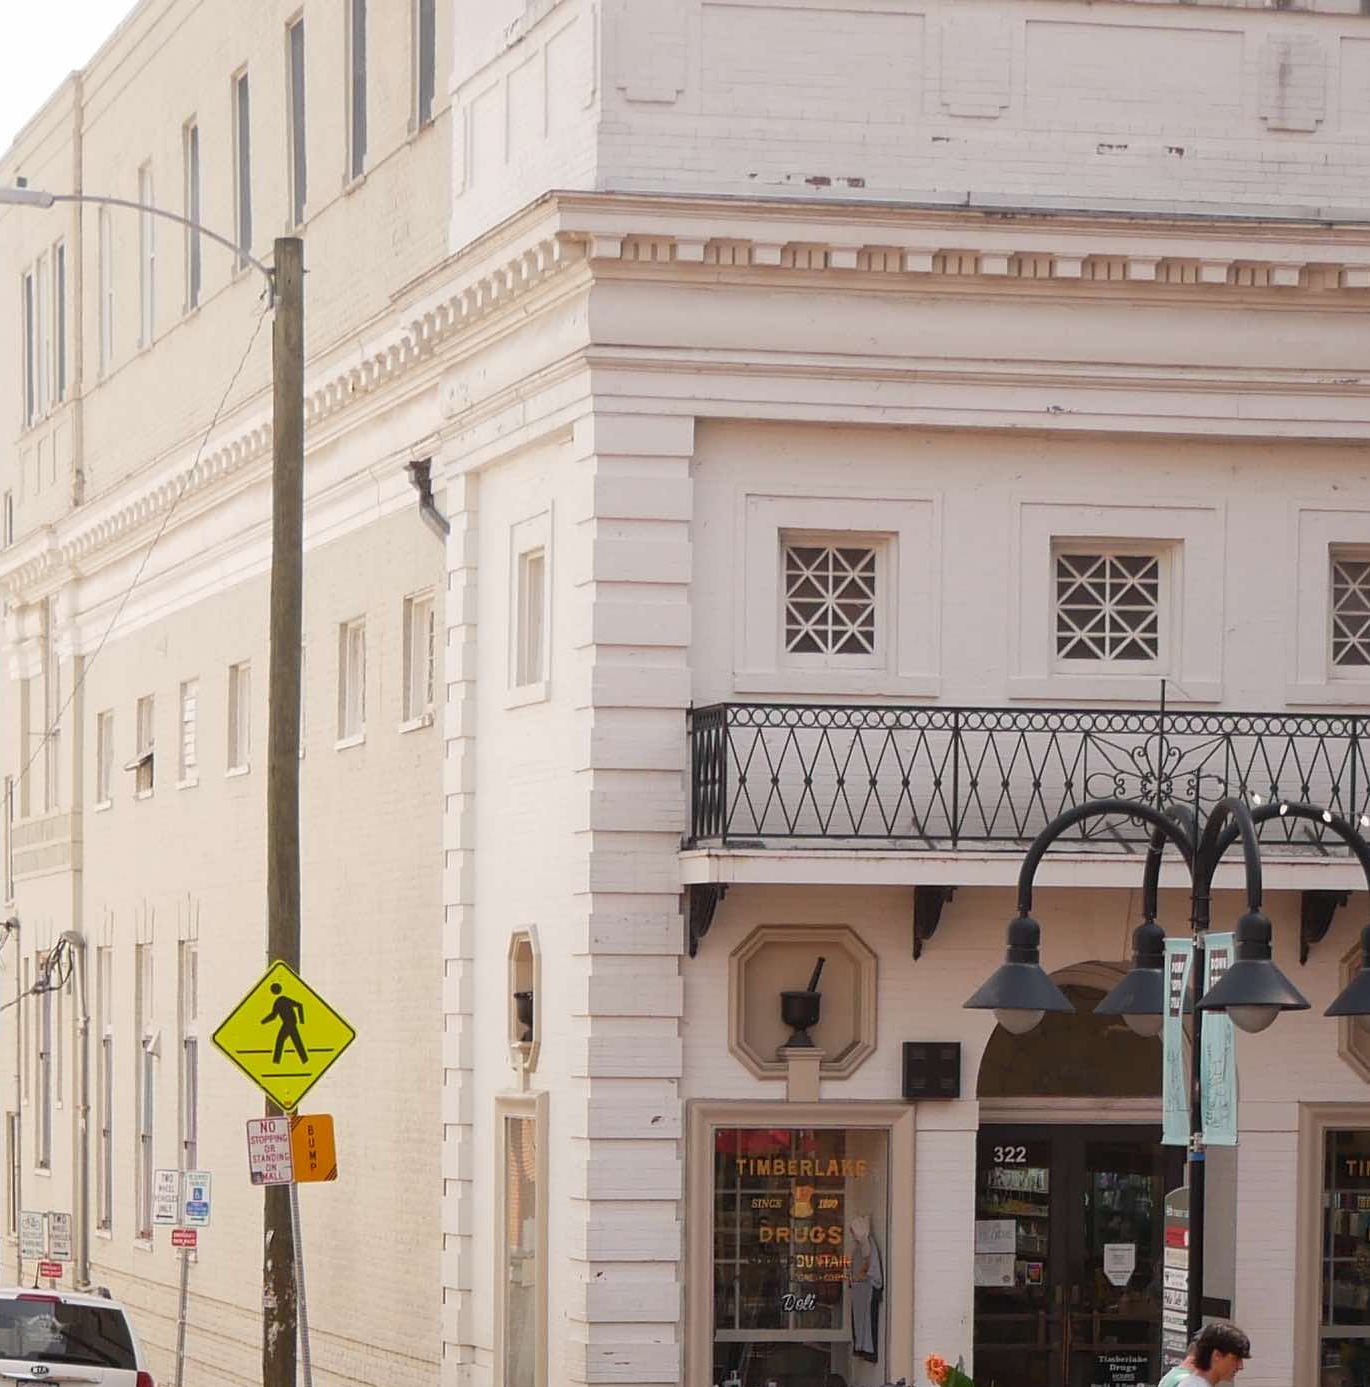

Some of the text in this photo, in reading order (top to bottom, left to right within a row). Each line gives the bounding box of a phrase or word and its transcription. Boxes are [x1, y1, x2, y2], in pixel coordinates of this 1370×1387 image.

[260, 1121, 276, 1134] NO
[250, 1134, 288, 1145] STOPPING
[264, 1145, 276, 1153] OR
[308, 1125, 318, 1172] BUMP
[993, 1146, 1027, 1163] 322
[253, 1153, 290, 1163] STANDING
[736, 1159, 868, 1177] TIMBERLAKE
[759, 1226, 842, 1244] DRUGS
[782, 1293, 816, 1311] Deli
[1109, 1364, 1136, 1373] Drugs
